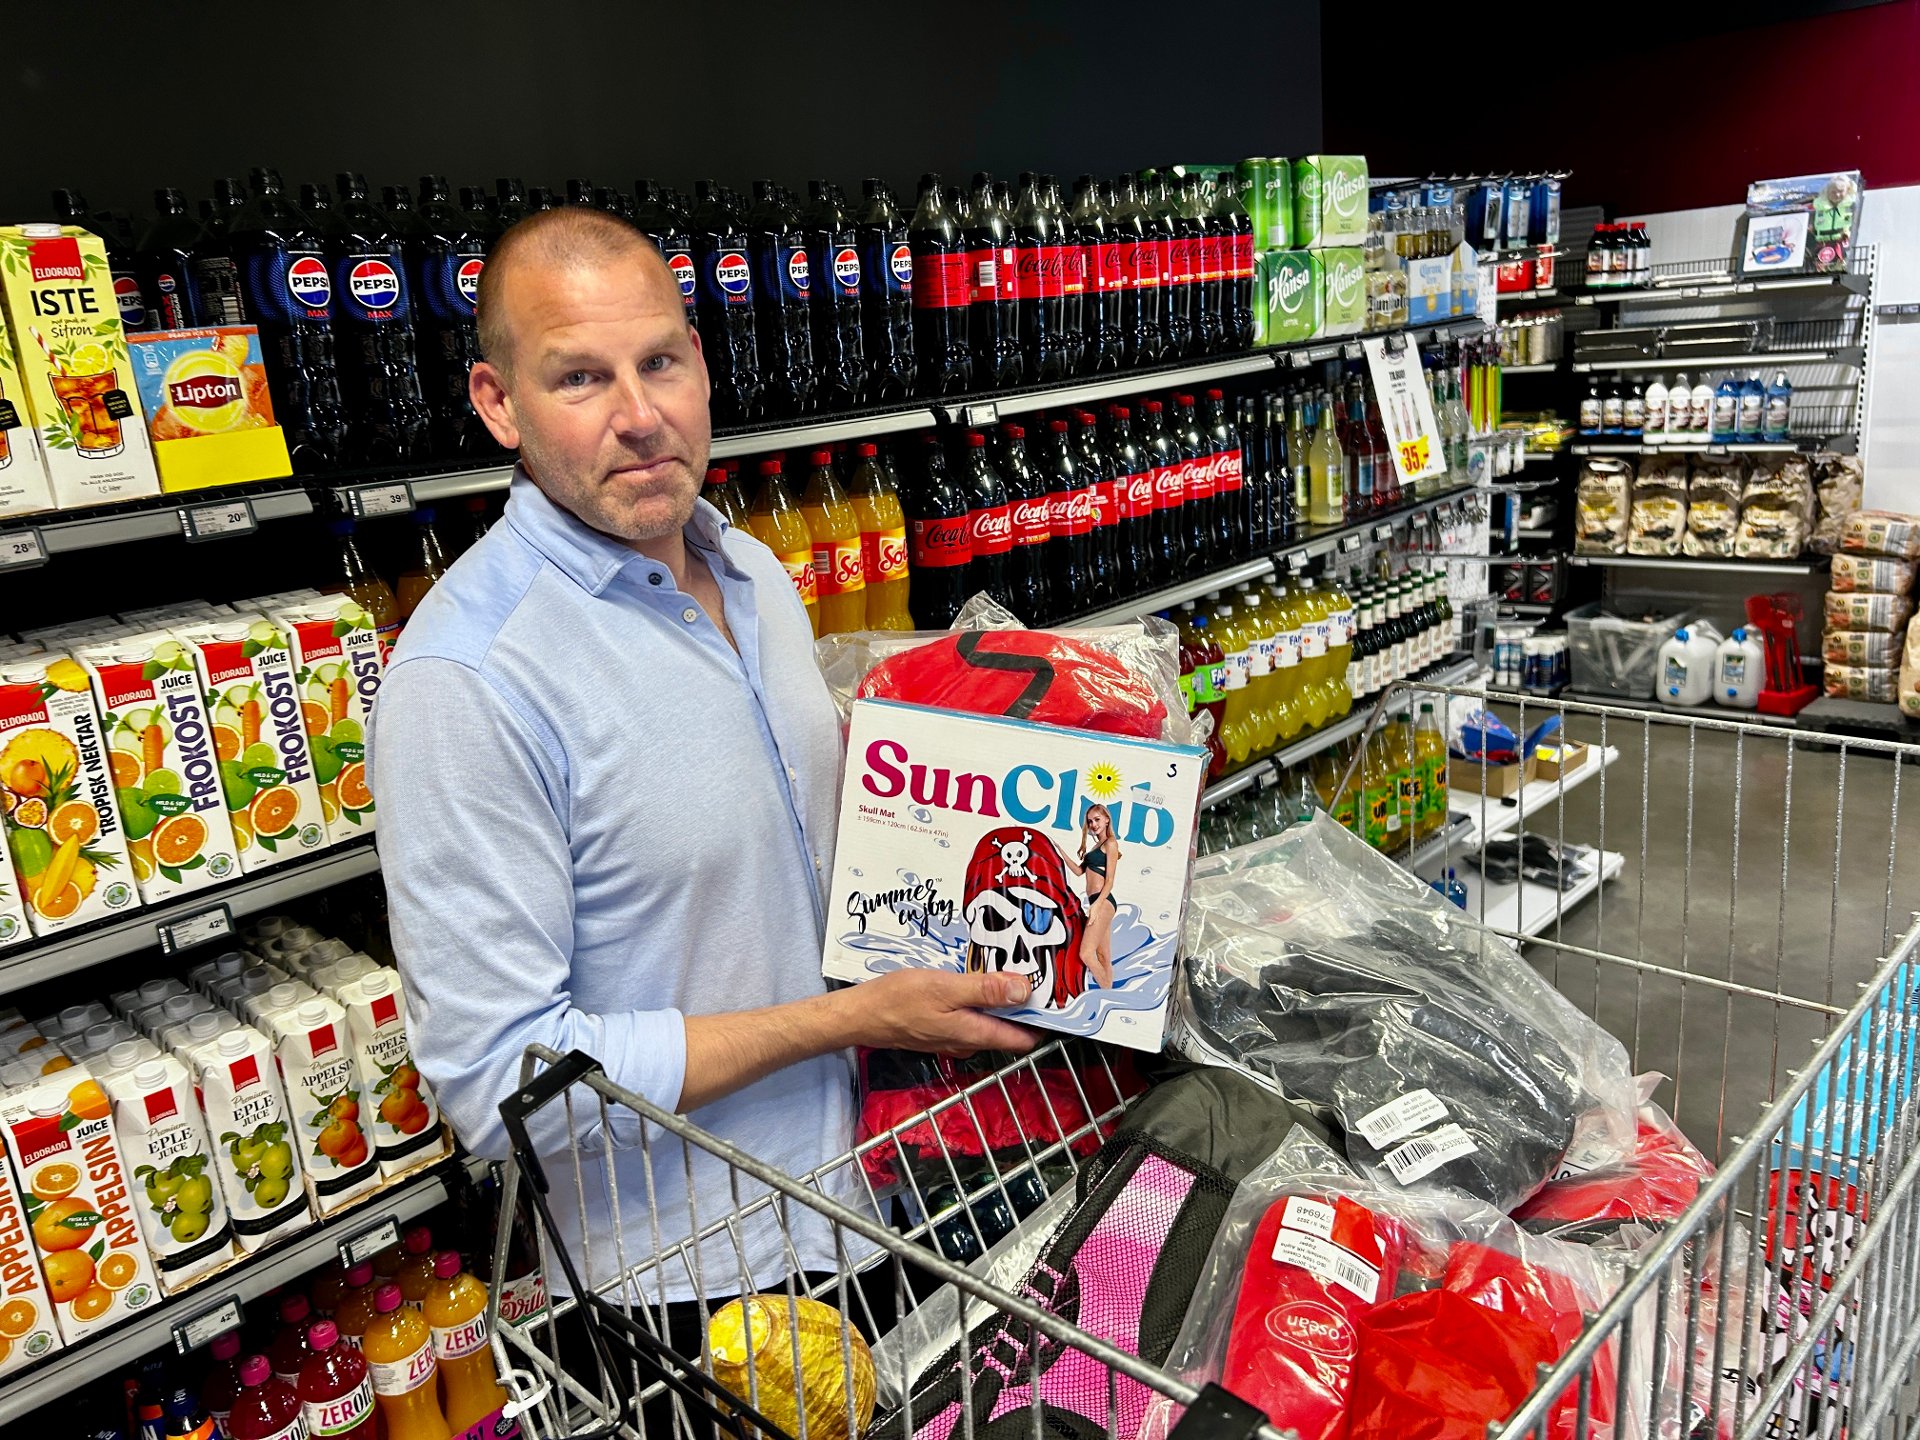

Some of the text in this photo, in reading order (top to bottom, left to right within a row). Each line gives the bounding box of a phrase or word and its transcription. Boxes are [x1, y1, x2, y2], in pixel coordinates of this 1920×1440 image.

[1322, 170, 1366, 216] Hansa
[35, 266, 82, 279] ELDORADO
[675, 270, 695, 281] EPSI
[718, 268, 749, 280] PEPSI
[292, 276, 330, 289] PEPSI
[353, 278, 397, 291] PEPSI
[1269, 266, 1310, 314] Hansa
[1326, 262, 1364, 308] Hansa
[30, 288, 100, 316] ISTE
[683, 296, 695, 304] AX
[728, 295, 747, 303] MAX
[307, 308, 329, 318] MAX
[367, 310, 393, 319] MAX
[51, 324, 93, 339] sitron
[176, 380, 238, 405] Lipton
[390, 494, 402, 504] 39
[227, 512, 241, 523] 20
[12, 543, 29, 554] 28
[790, 562, 816, 591] olo
[346, 632, 374, 647] JUICE
[258, 652, 287, 667] JUICE
[304, 644, 340, 661] ELDORADO
[160, 674, 193, 690] JUICE
[211, 666, 251, 684] ELDORADO
[109, 689, 153, 707] ELDORADO
[0, 711, 46, 731] ELDORADO
[262, 670, 312, 785] FROKOST
[166, 694, 221, 813] FROKOST
[73, 712, 117, 838] TROPISK NEKTAR
[861, 738, 1175, 848] SunClub
[858, 804, 896, 819] Skull Mat
[863, 815, 882, 825] 159cm
[887, 820, 907, 829] 120cm
[933, 829, 949, 838] 47in)
[847, 878, 938, 935] Summer
[208, 920, 220, 930] 42
[898, 898, 954, 938] enjoy
[365, 1032, 407, 1055] APPELS
[382, 1044, 406, 1061] JUICE
[309, 1056, 347, 1073] Premium
[319, 1073, 346, 1092] JUICE
[231, 1088, 270, 1109] Premium
[241, 1108, 270, 1128] JUICE
[75, 1118, 110, 1140] JUICE
[147, 1121, 189, 1139] Premium
[24, 1140, 68, 1165] ELDORADO
[157, 1141, 189, 1161] JUICE
[81, 1134, 139, 1250] APPELSIN
[380, 1232, 391, 1242] 48
[219, 1313, 233, 1324] 42
[1286, 1314, 1341, 1341] osean
